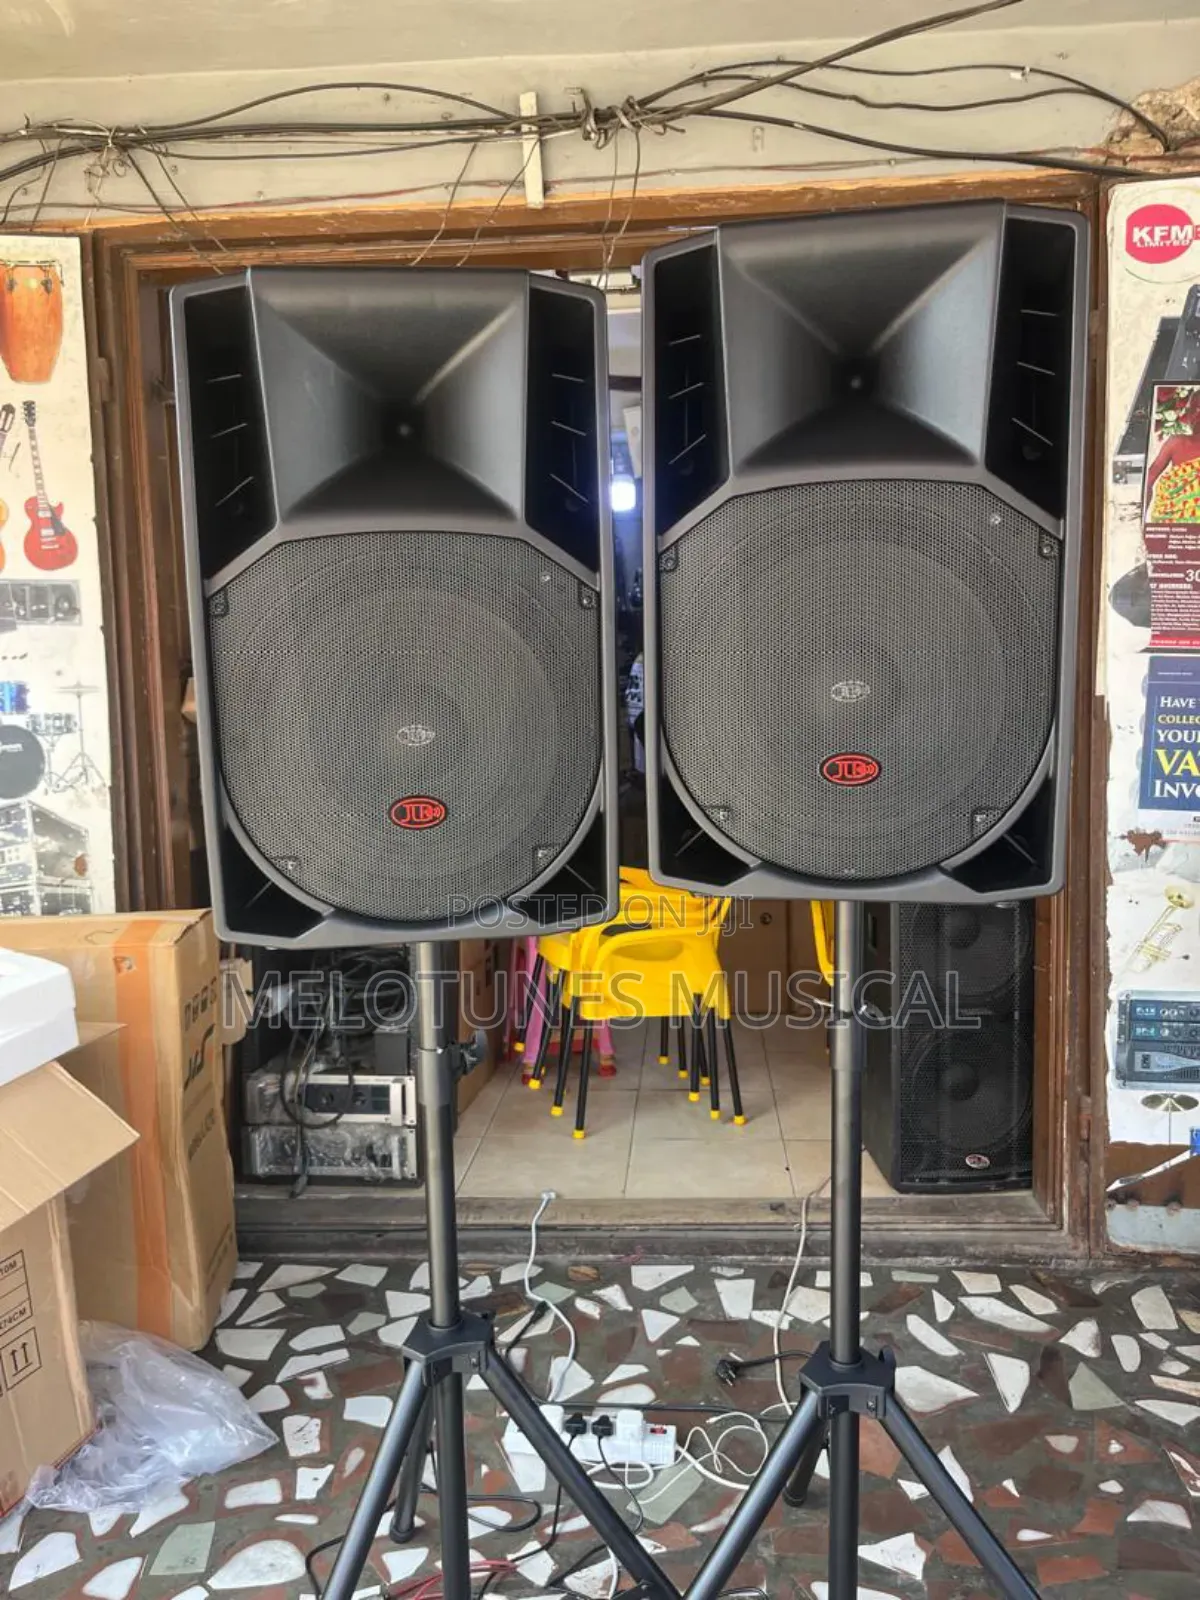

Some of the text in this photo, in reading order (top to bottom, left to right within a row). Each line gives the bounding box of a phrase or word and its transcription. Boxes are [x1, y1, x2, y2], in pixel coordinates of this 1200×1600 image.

[1132, 224, 1193, 243] KFM
[1137, 240, 1190, 248] LIMITED
[1159, 696, 1197, 708] HAVE
[1155, 730, 1200, 743] YOU
[1154, 748, 1200, 777] VA
